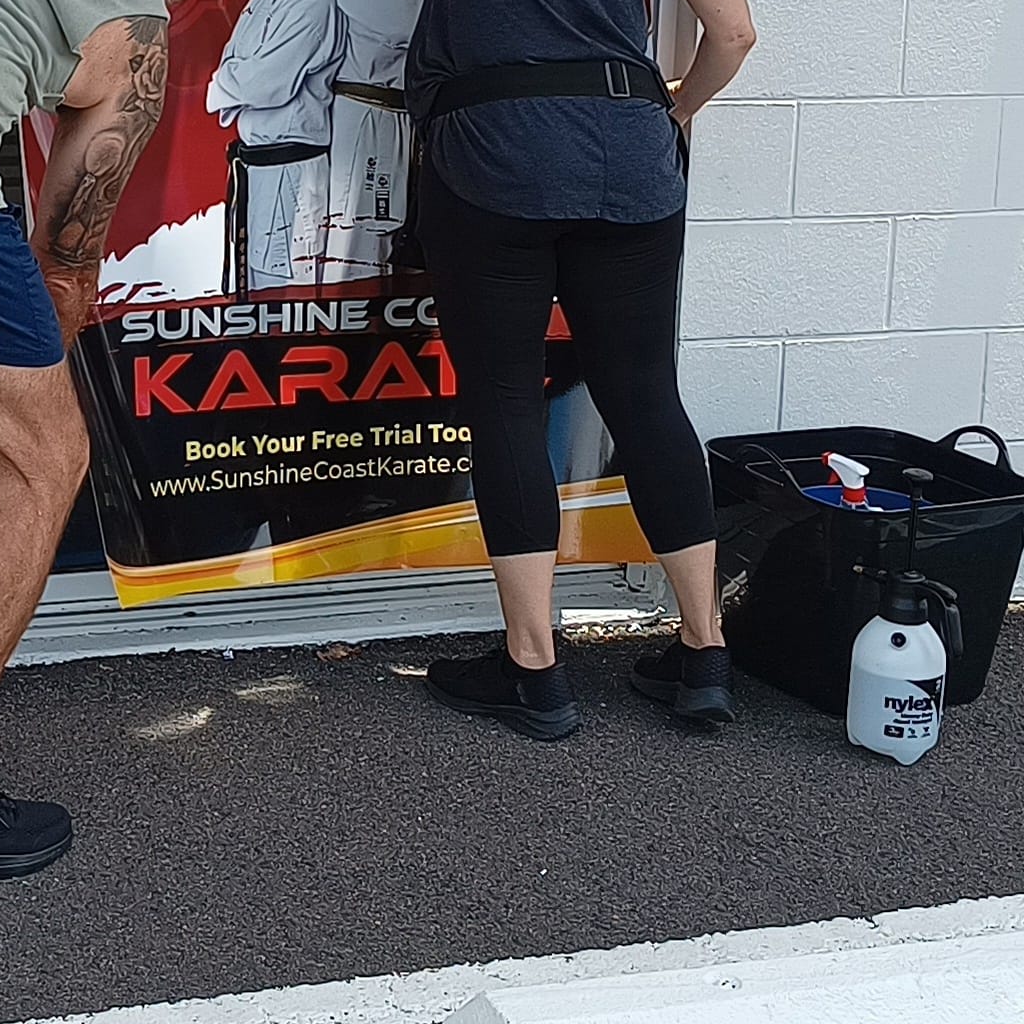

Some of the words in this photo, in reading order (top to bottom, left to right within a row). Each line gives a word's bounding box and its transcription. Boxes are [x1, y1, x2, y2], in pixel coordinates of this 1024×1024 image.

[121, 298, 370, 344] SUNSHINE
[185, 434, 246, 461] Book
[253, 432, 305, 456] Your
[311, 427, 364, 452] Free
[370, 423, 422, 448] Trial
[150, 453, 473, 497] www.SunshineCoastKarate.c
